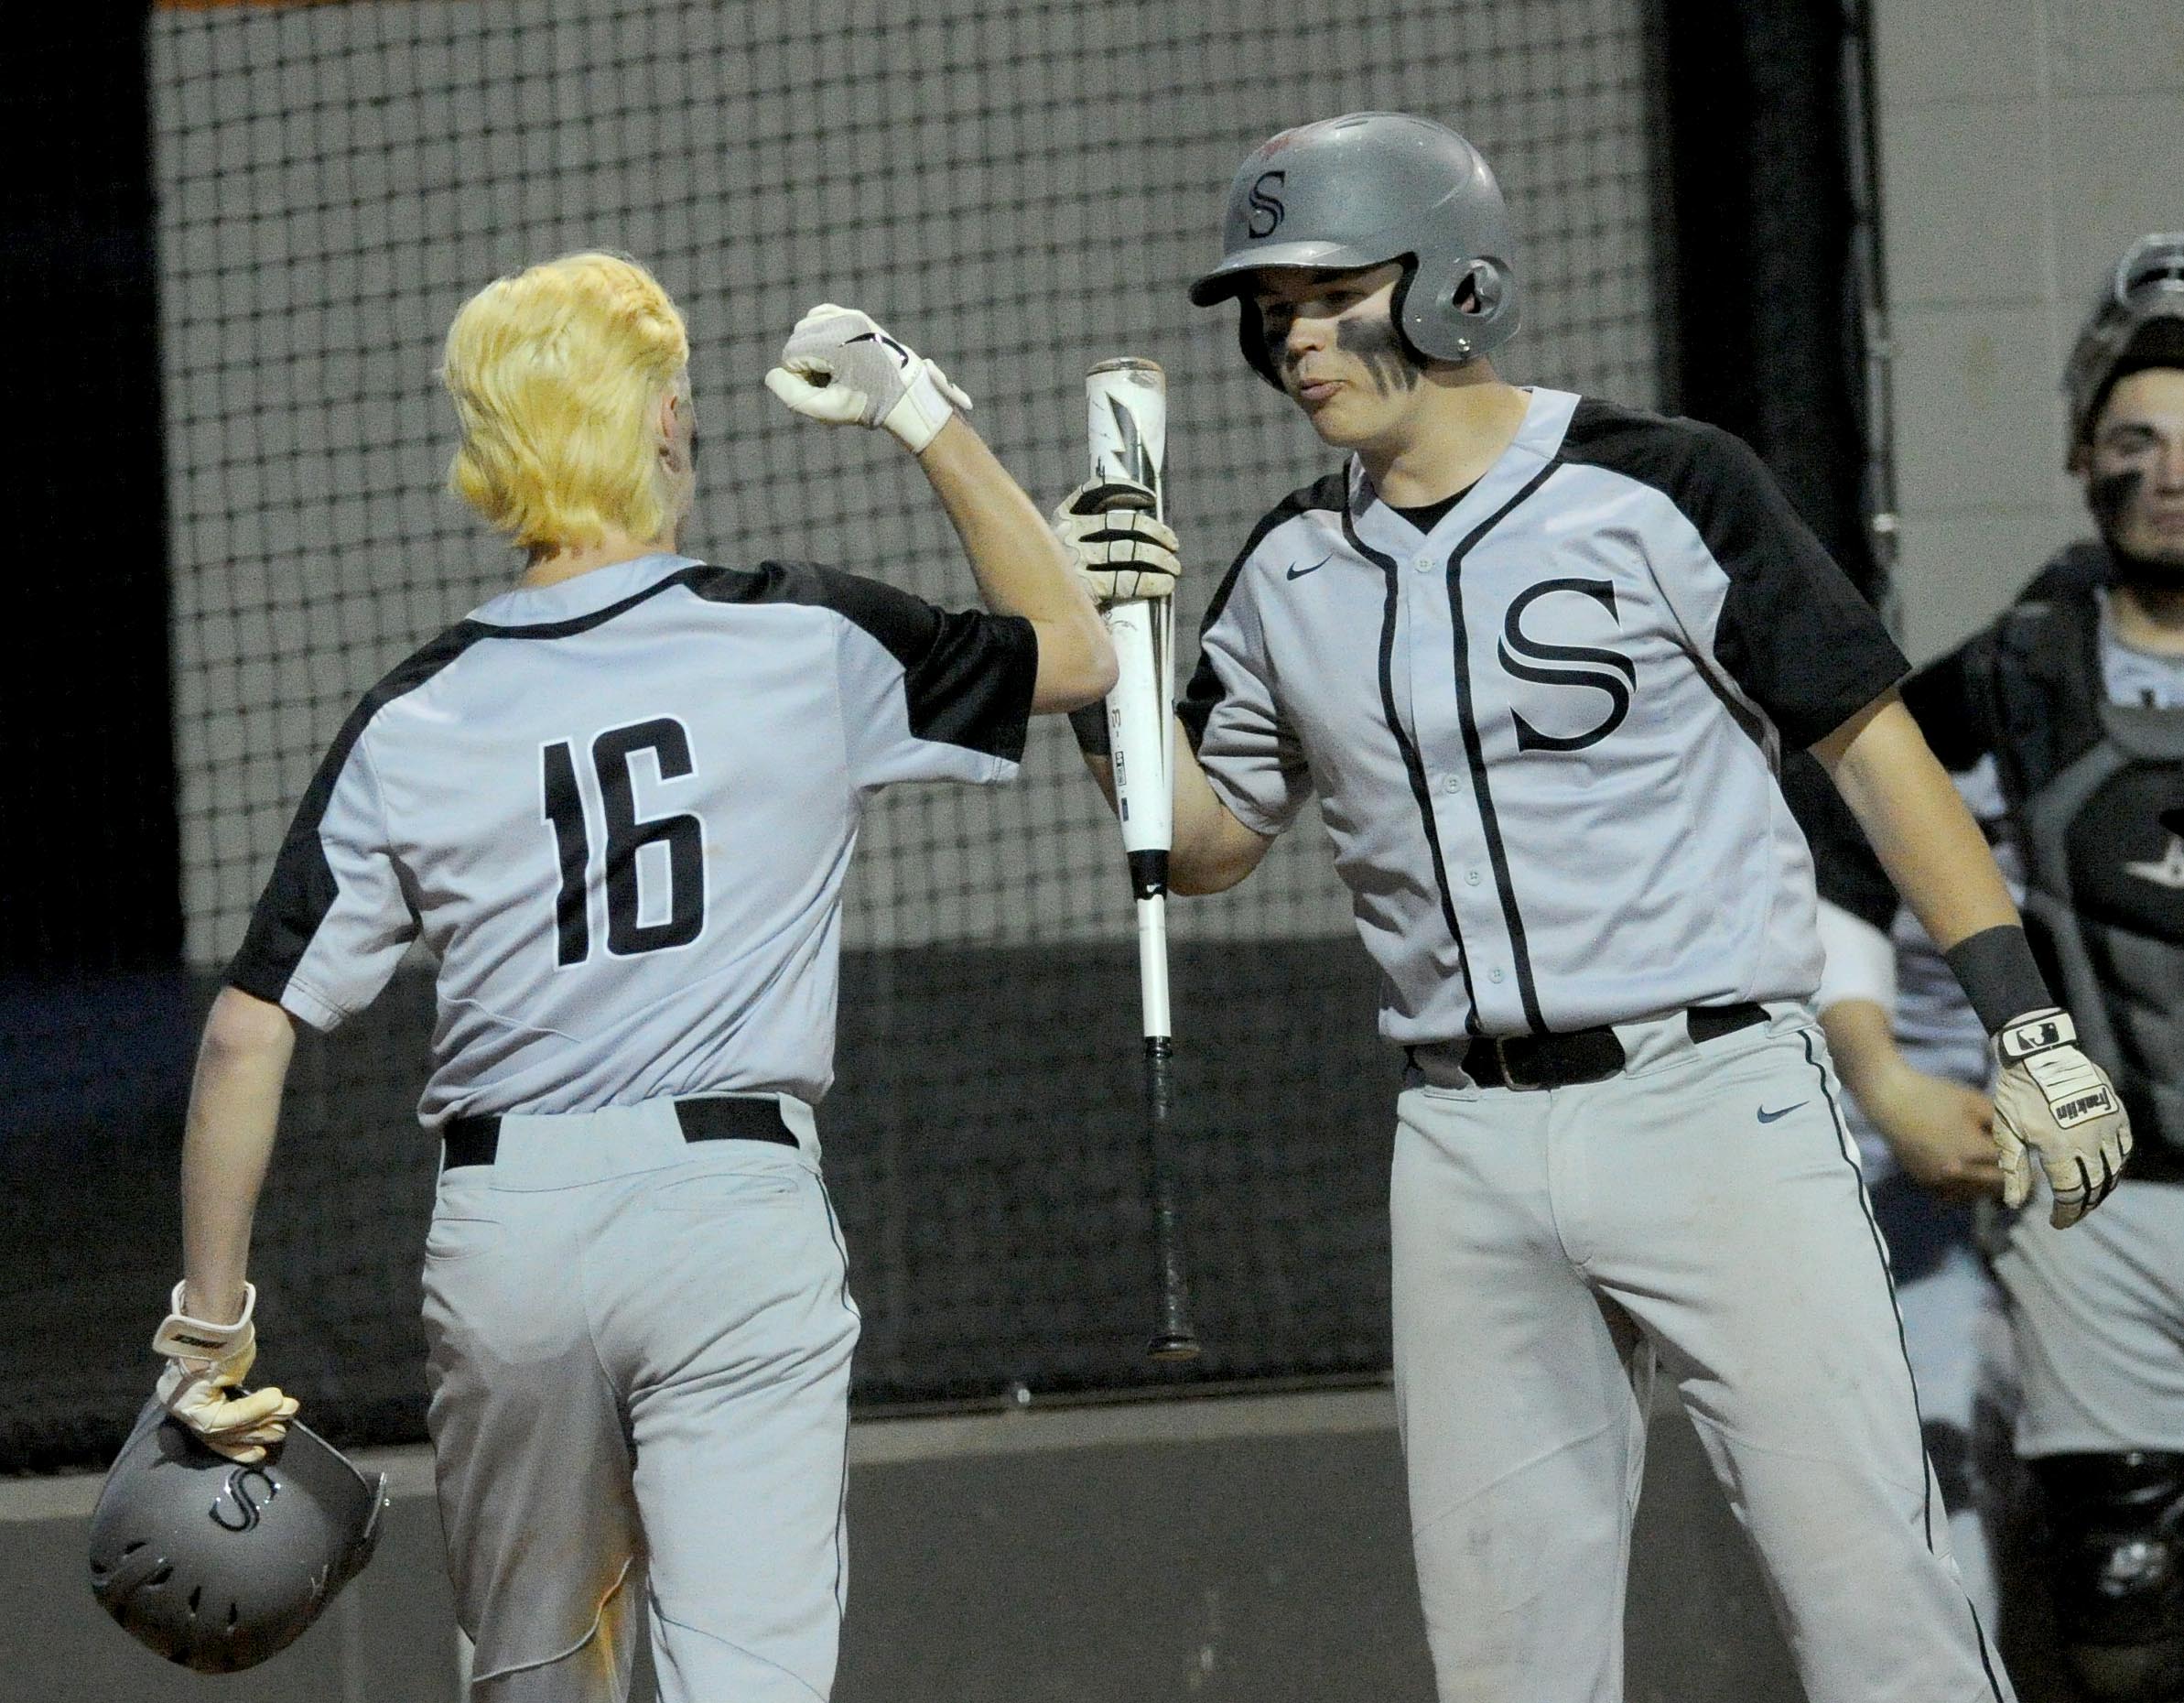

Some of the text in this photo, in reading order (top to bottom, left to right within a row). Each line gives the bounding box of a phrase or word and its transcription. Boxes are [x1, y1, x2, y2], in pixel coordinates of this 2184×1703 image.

[1248, 170, 1286, 240] S
[1497, 577, 1638, 754] S
[539, 713, 708, 970] 16
[209, 1466, 279, 1533] S
